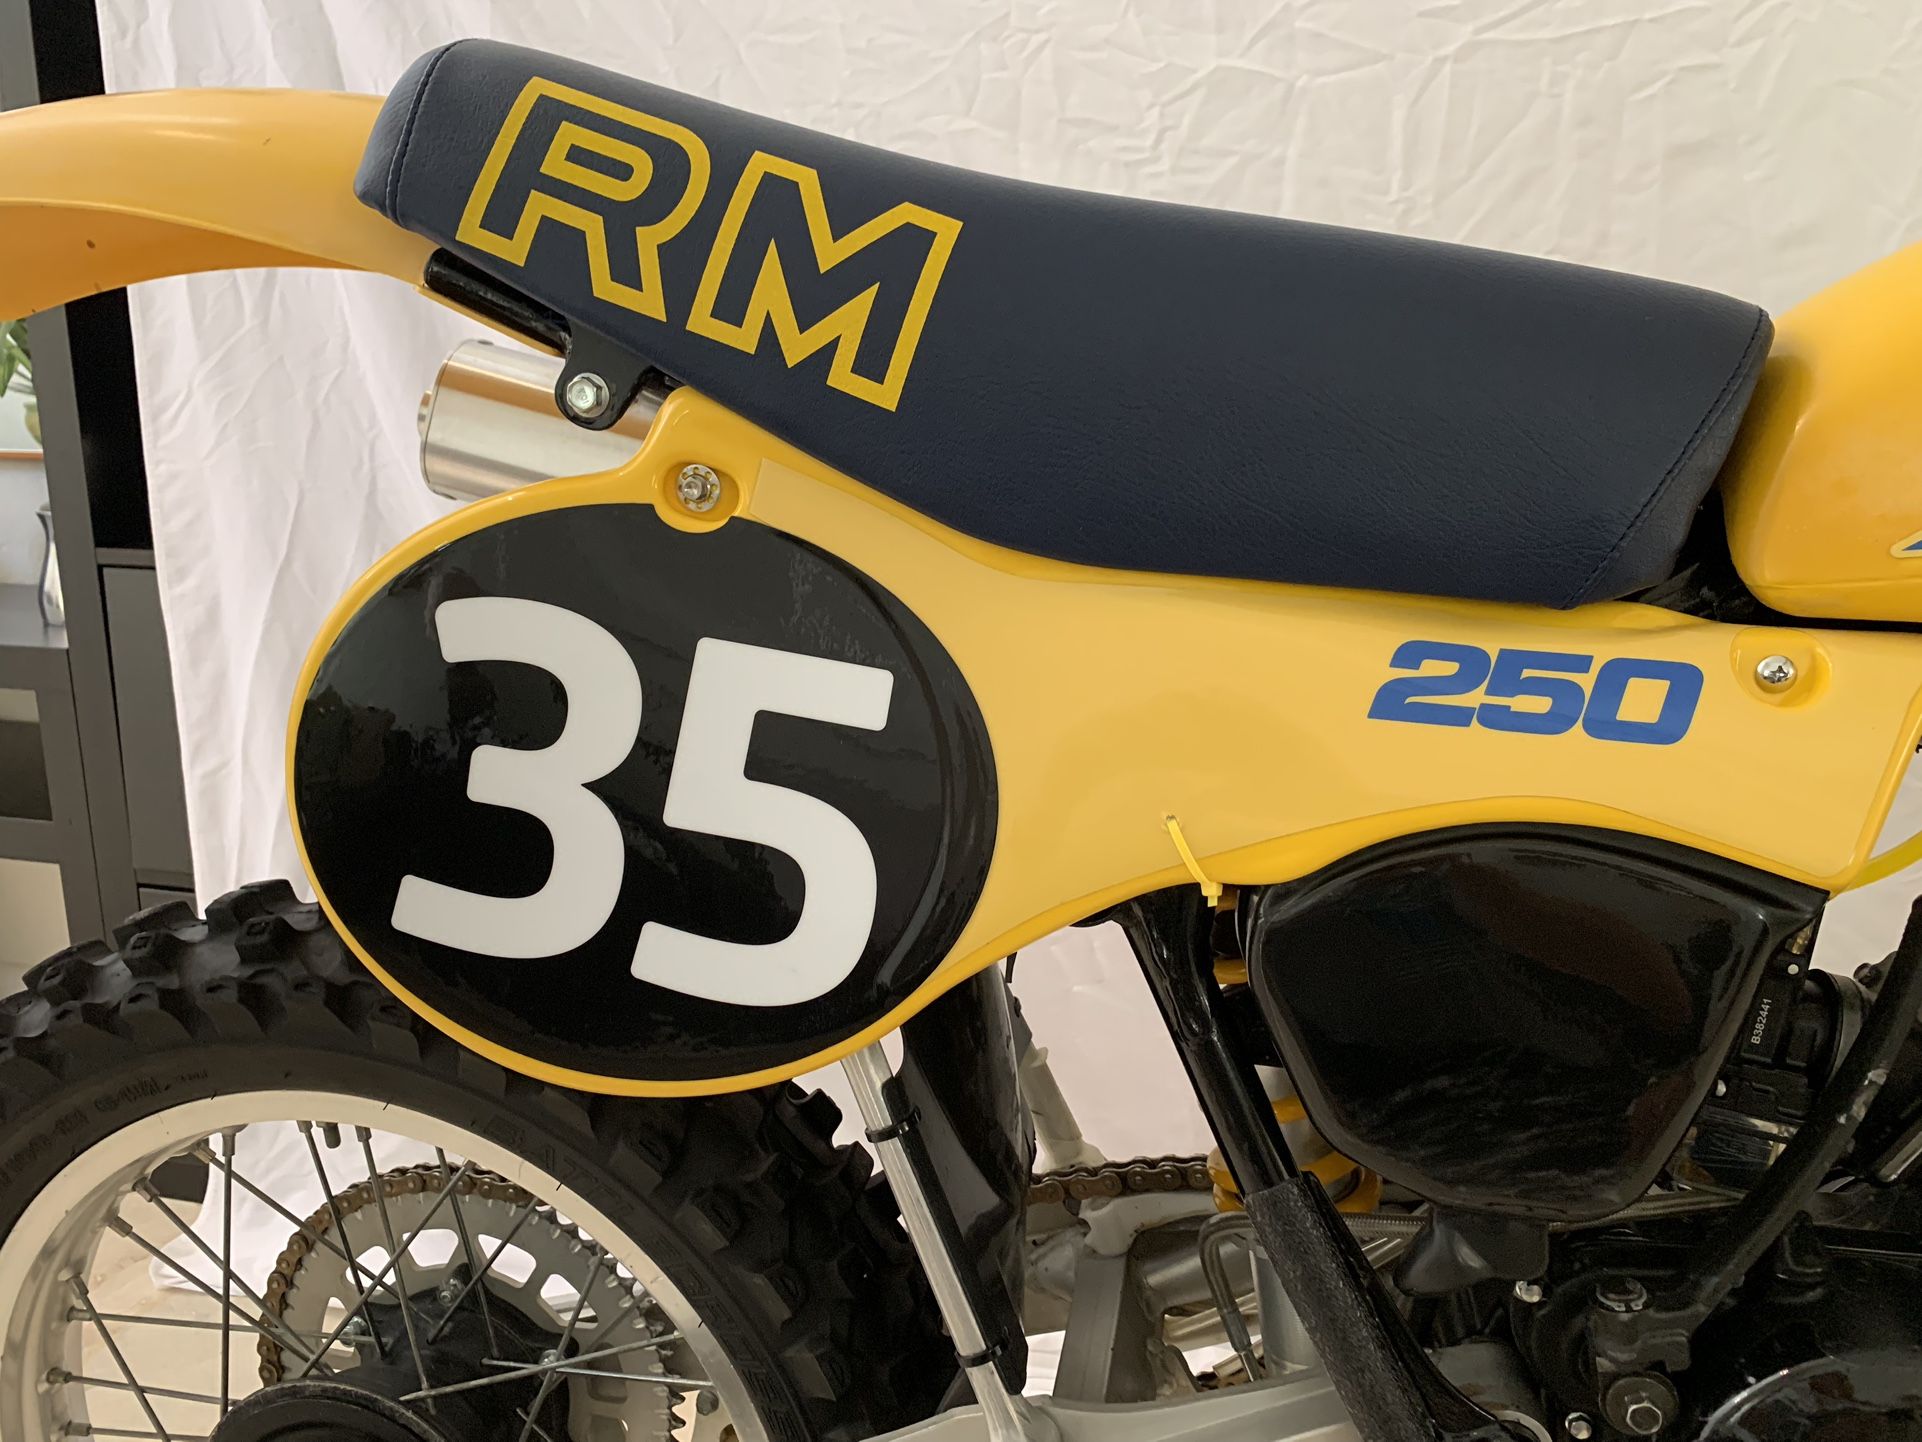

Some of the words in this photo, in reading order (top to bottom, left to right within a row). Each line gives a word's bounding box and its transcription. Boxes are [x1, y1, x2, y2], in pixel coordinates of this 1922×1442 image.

[456, 76, 964, 413] RM
[391, 596, 894, 1008] 35
[1367, 639, 1704, 746] 250
[1750, 998, 1772, 1045] B382441
